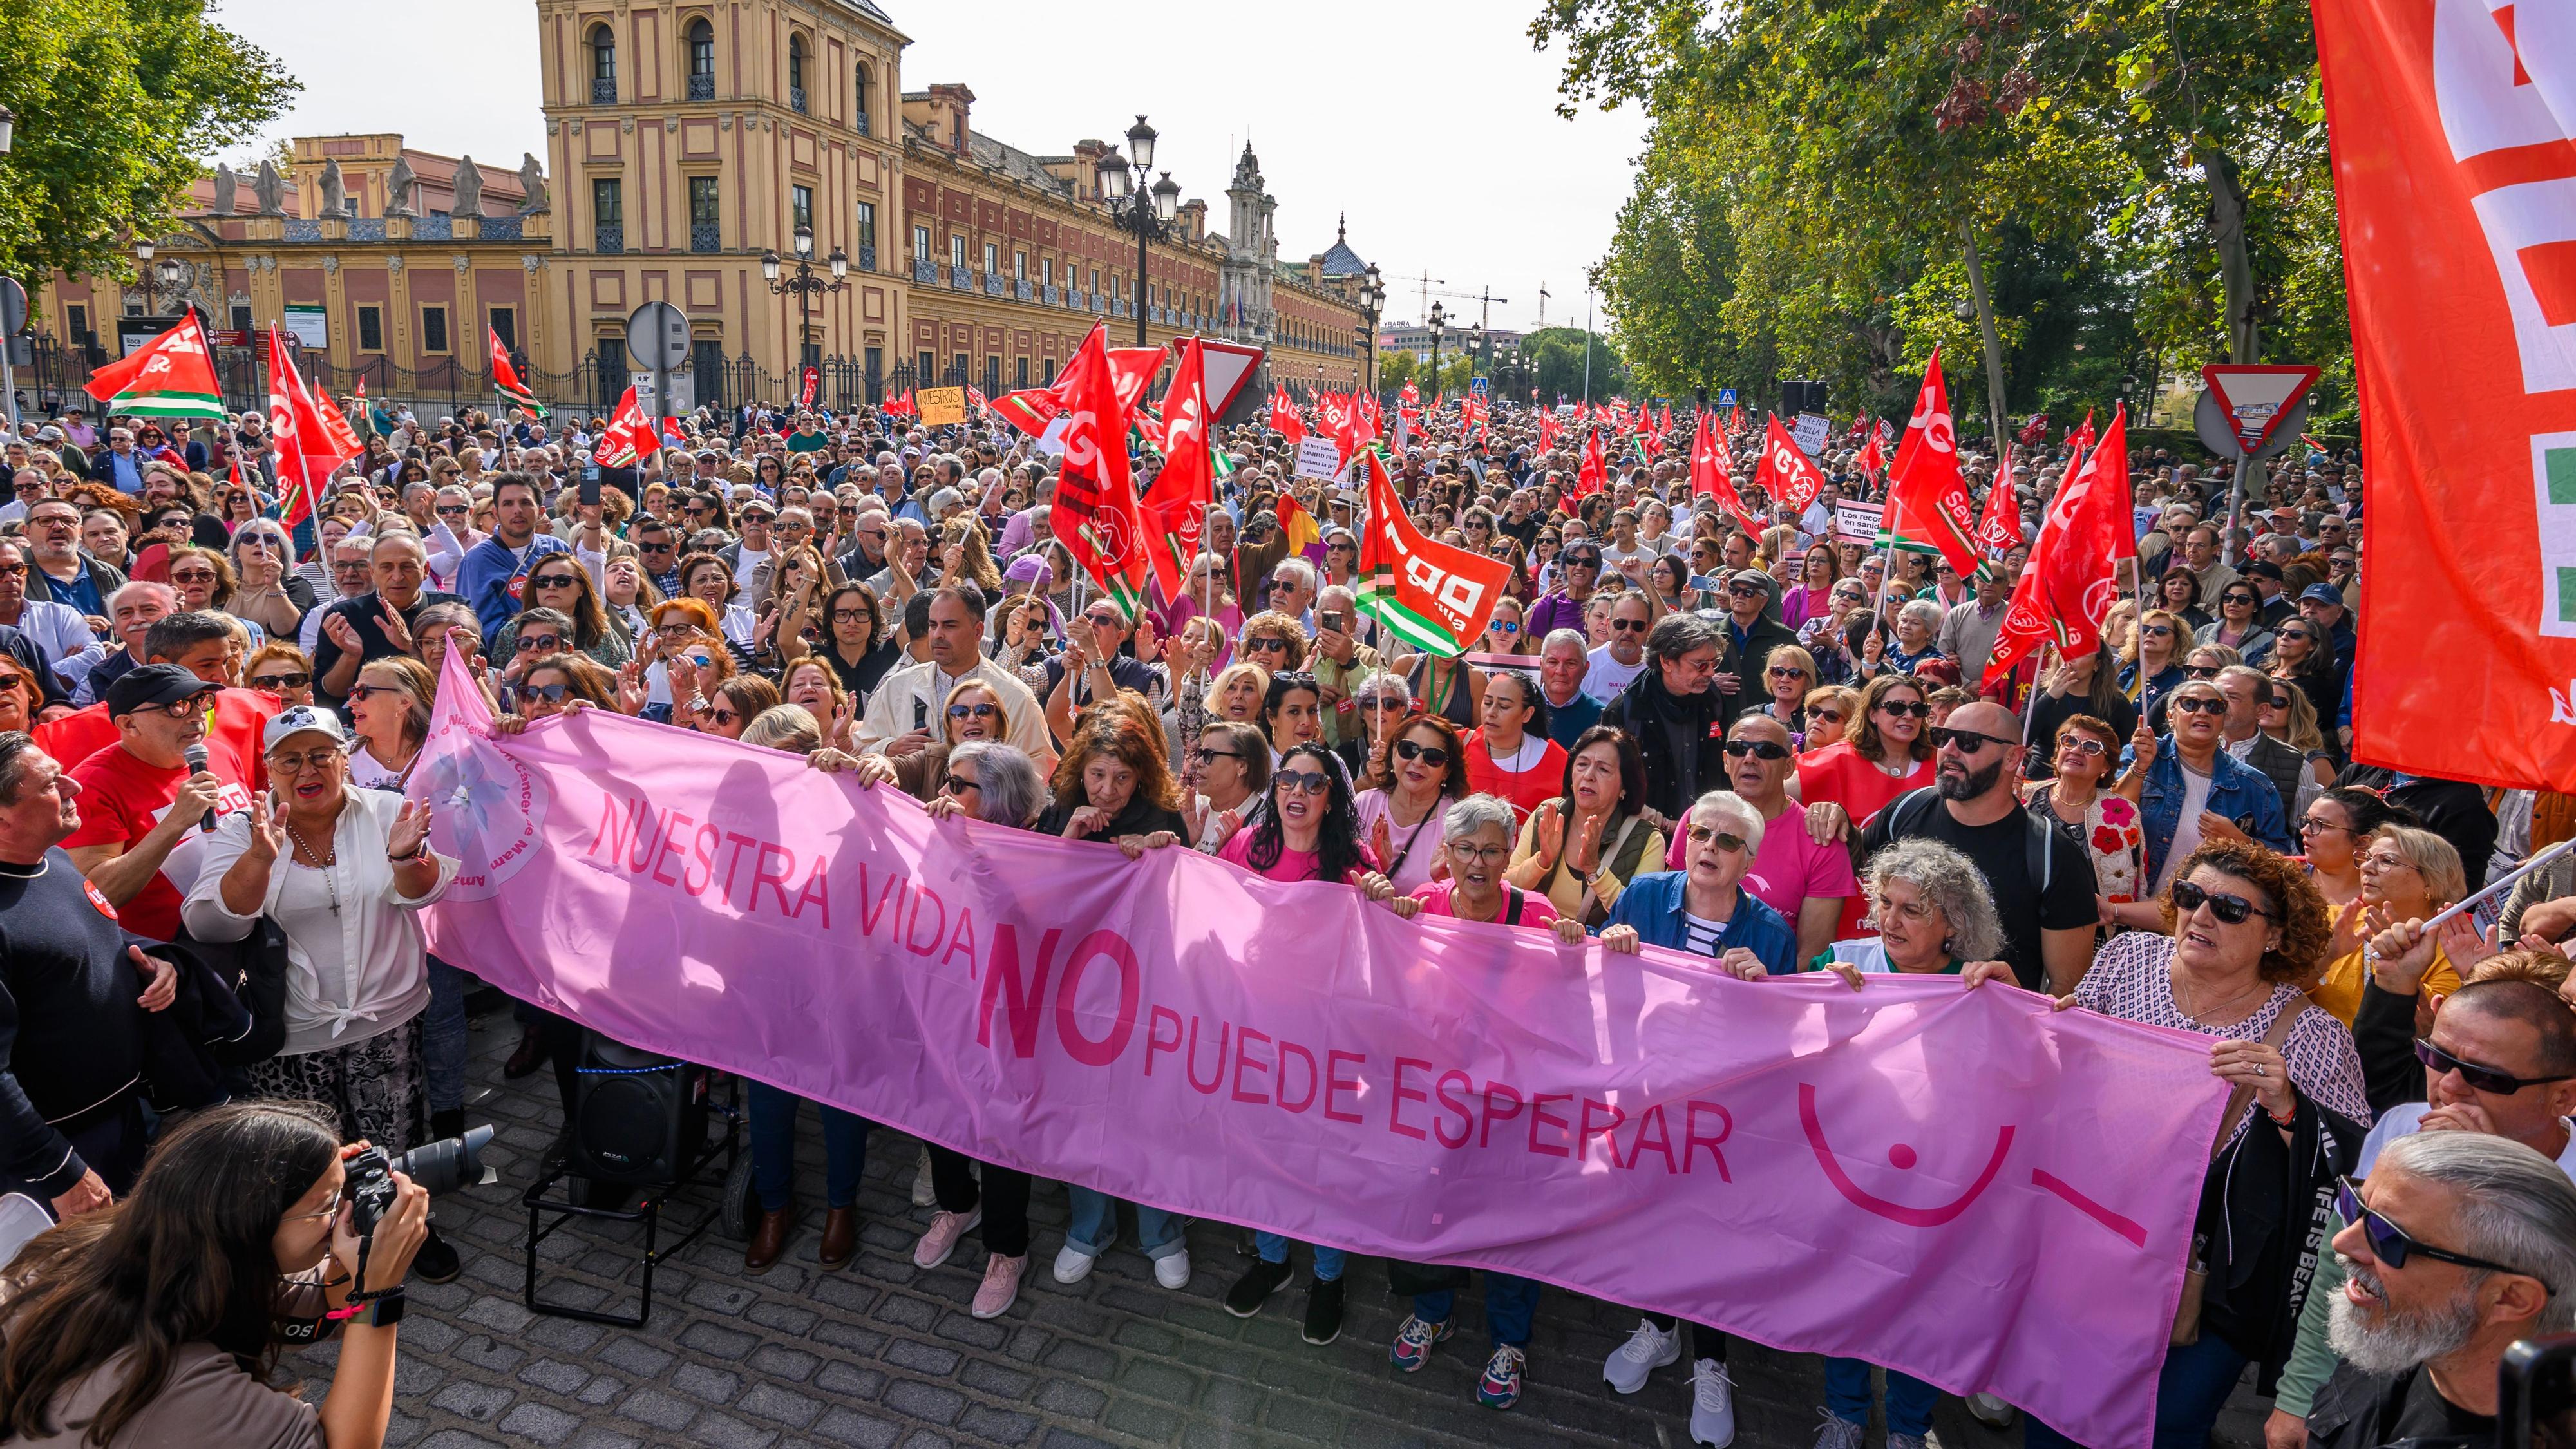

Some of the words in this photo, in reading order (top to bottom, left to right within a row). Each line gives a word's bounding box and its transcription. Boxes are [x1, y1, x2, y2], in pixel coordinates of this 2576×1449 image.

[920, 389, 960, 405] NUESTROS
[1277, 395, 1302, 427] UG
[1795, 424, 1820, 437] BONILLA
[1799, 415, 1828, 427] MORENO
[1793, 433, 1812, 444] FUERA
[1842, 511, 1857, 519] Los
[1859, 514, 1882, 523] recor
[1856, 520, 1879, 529] sanid
[515, 762, 532, 816] Cáncer
[490, 838, 529, 871] Mam
[88, 889, 108, 904] UG
[587, 792, 831, 930] NUESTRA
[860, 862, 976, 980] VIDA
[976, 922, 1140, 1066] NO
[1144, 1003, 1366, 1124] PUEDE
[1389, 1056, 1734, 1184] ESPERAR
[2313, 1186, 2334, 1224] IFE
[2306, 1227, 2325, 1249] IS
[2289, 1251, 2317, 1319] BEAU
